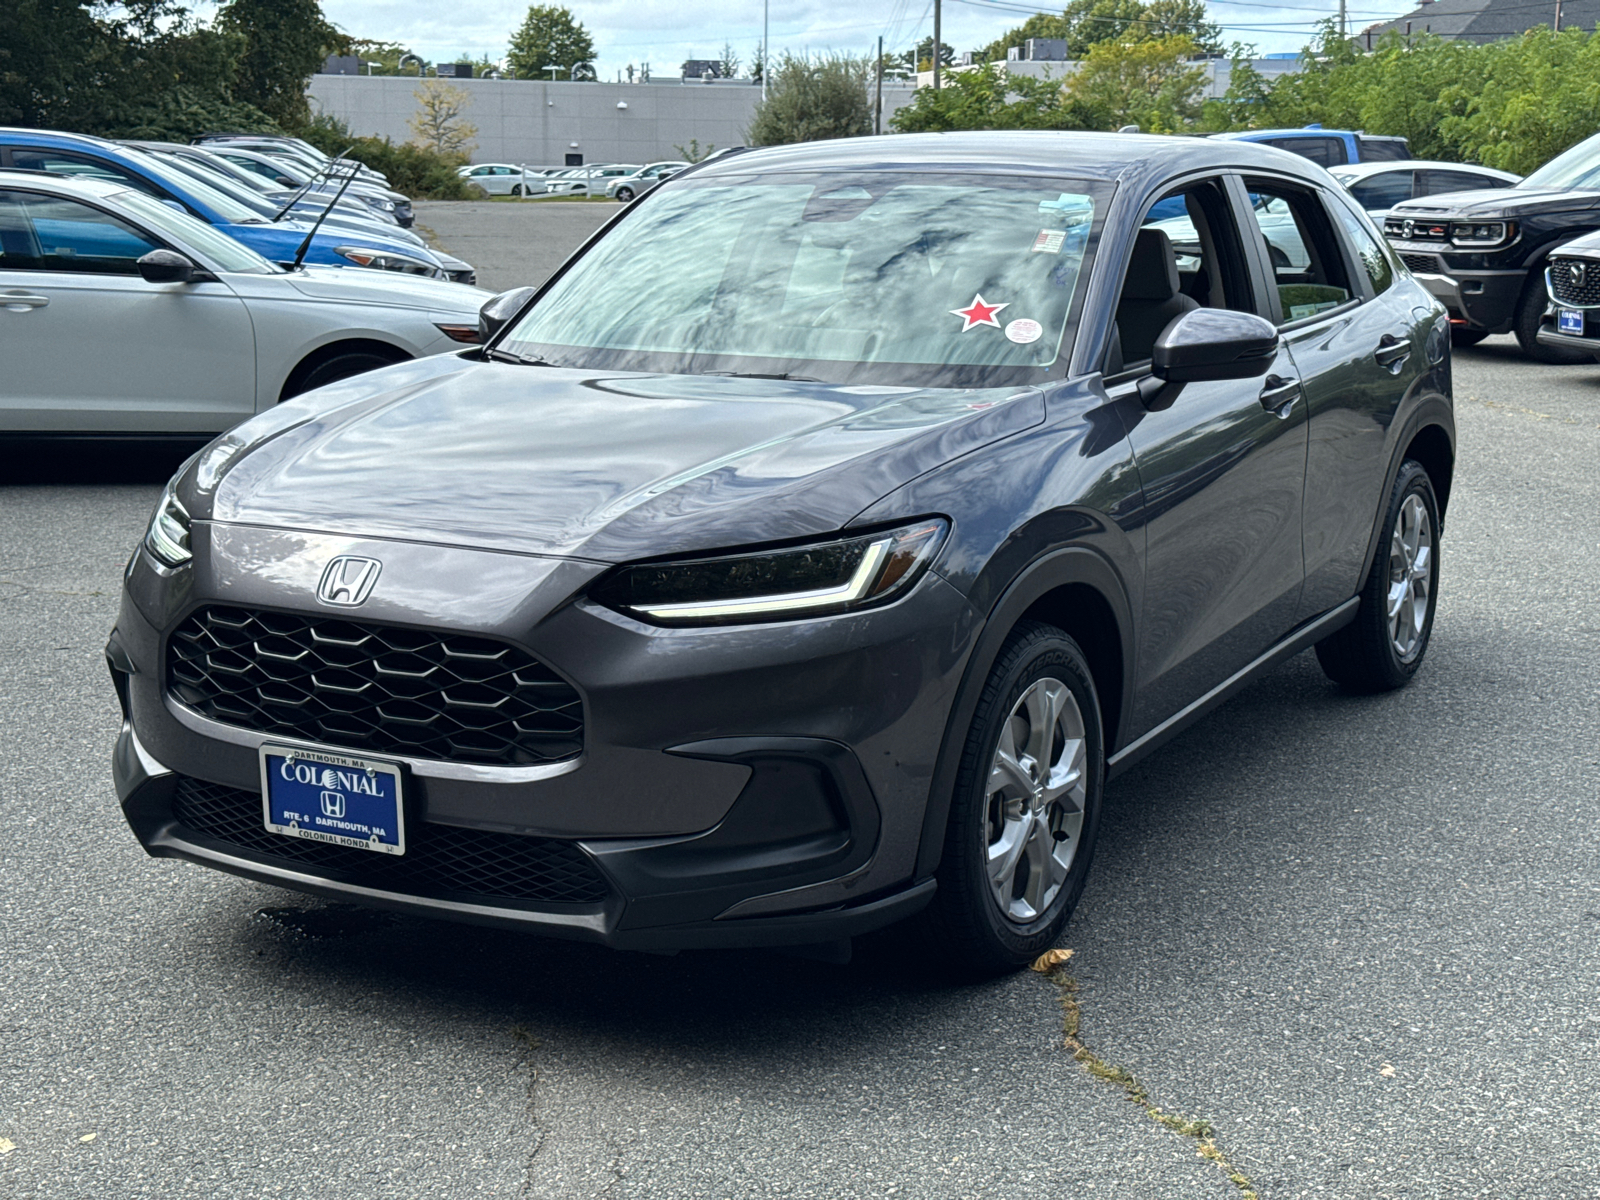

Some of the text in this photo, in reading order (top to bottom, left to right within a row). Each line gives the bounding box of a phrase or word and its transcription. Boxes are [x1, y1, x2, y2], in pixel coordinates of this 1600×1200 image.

[352, 760, 365, 768] MA
[281, 763, 383, 797] COLONIAL
[283, 811, 387, 836] RTE. 6 DARTMOUTH, MA
[298, 830, 370, 849] COLONIAL HONDA
